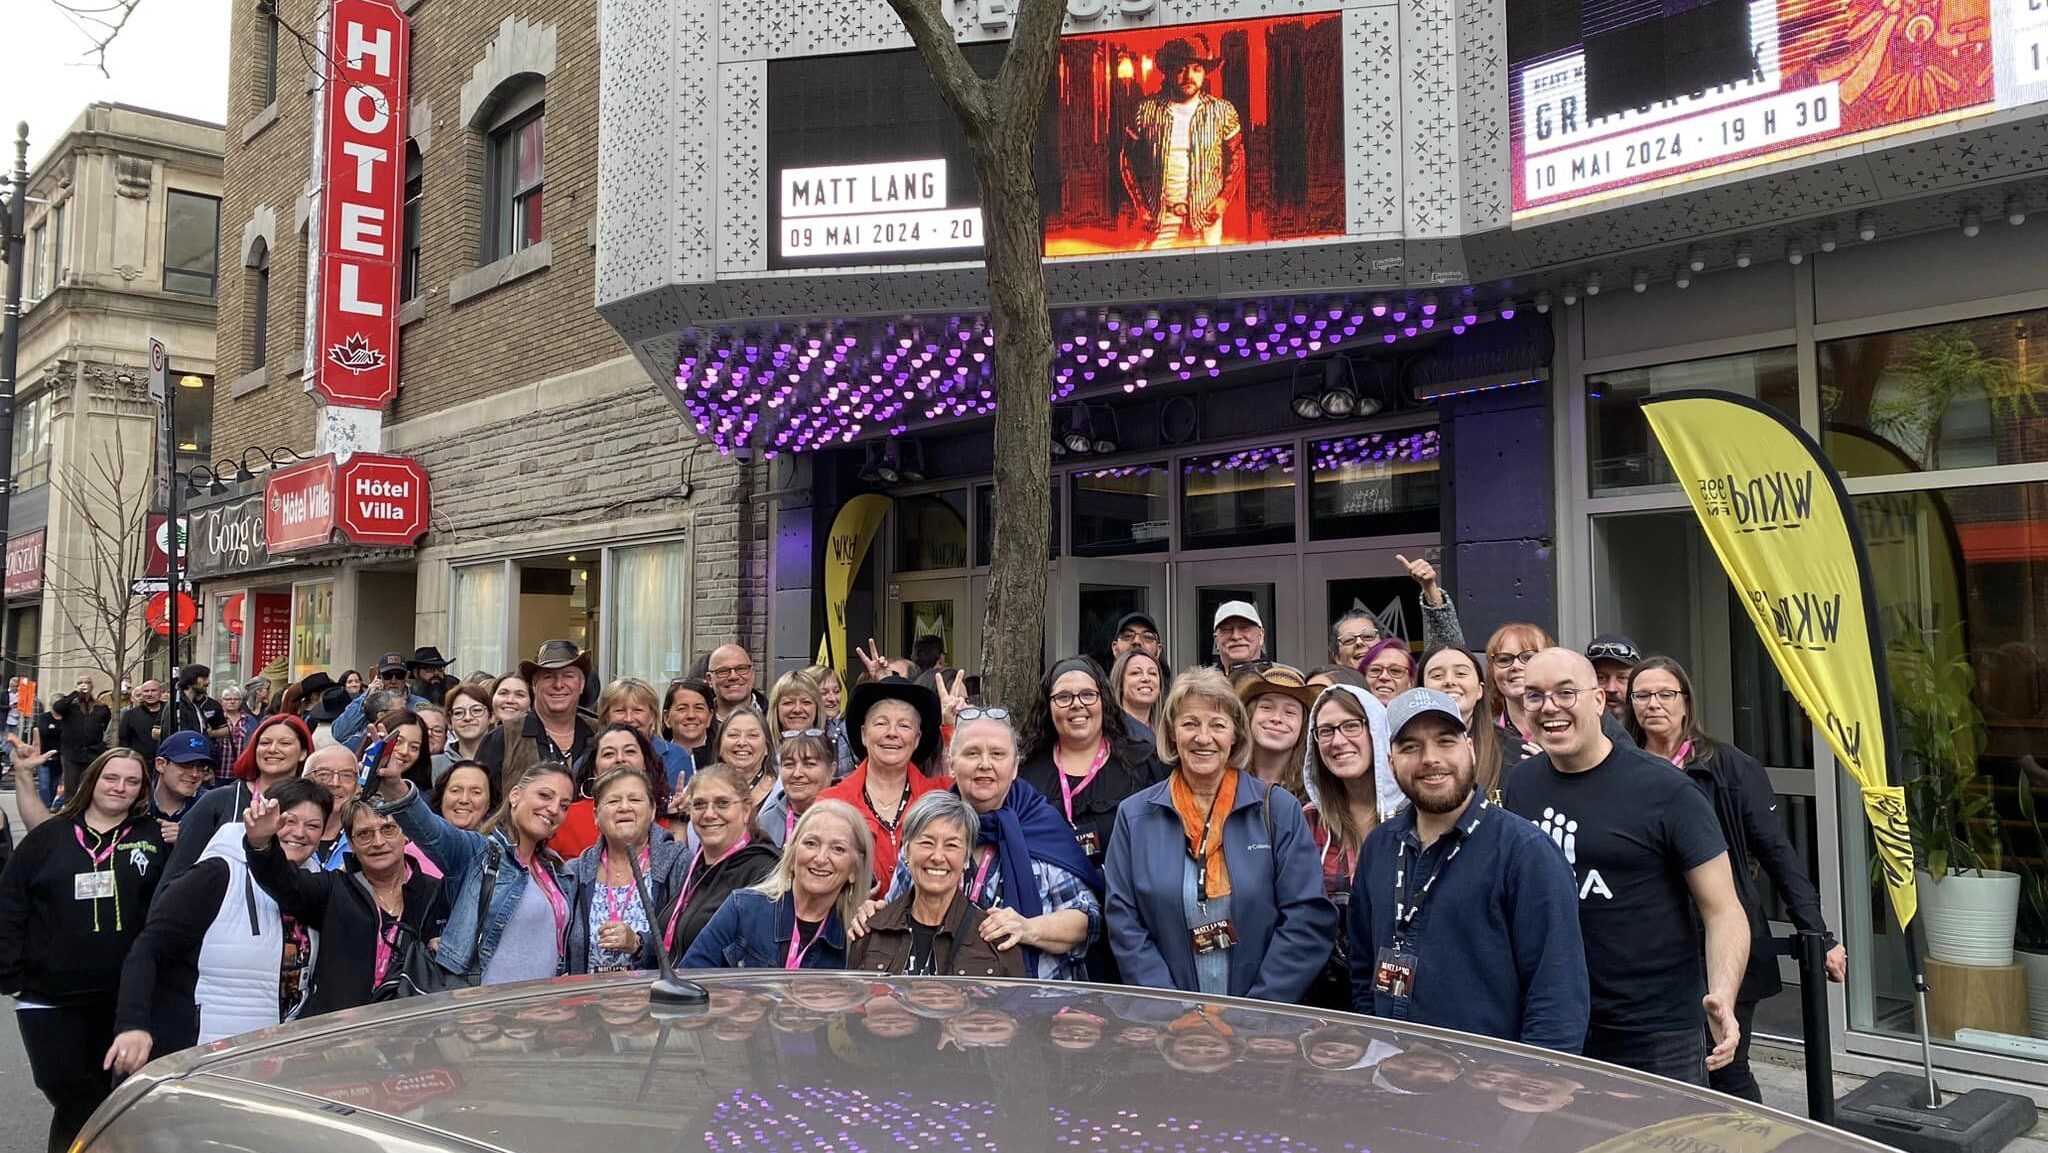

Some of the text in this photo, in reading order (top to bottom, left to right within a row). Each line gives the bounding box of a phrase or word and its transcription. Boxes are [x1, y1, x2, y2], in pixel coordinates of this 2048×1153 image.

[1536, 164, 1556, 189] 10
[1571, 154, 1610, 182] MAI
[1626, 133, 1682, 168] 2024
[1721, 117, 1745, 145] 19
[1764, 109, 1776, 136] H
[1796, 97, 1828, 127] 30
[338, 21, 391, 317] HOTEL
[792, 172, 934, 207] MATT LANG
[790, 218, 972, 248] 09 MAI 2024 20
[282, 483, 331, 526] Hôtel Villa
[356, 479, 409, 498] Hôtel
[359, 502, 404, 520] Villa
[208, 513, 264, 566] Gong c
[1574, 869, 1613, 899] A
